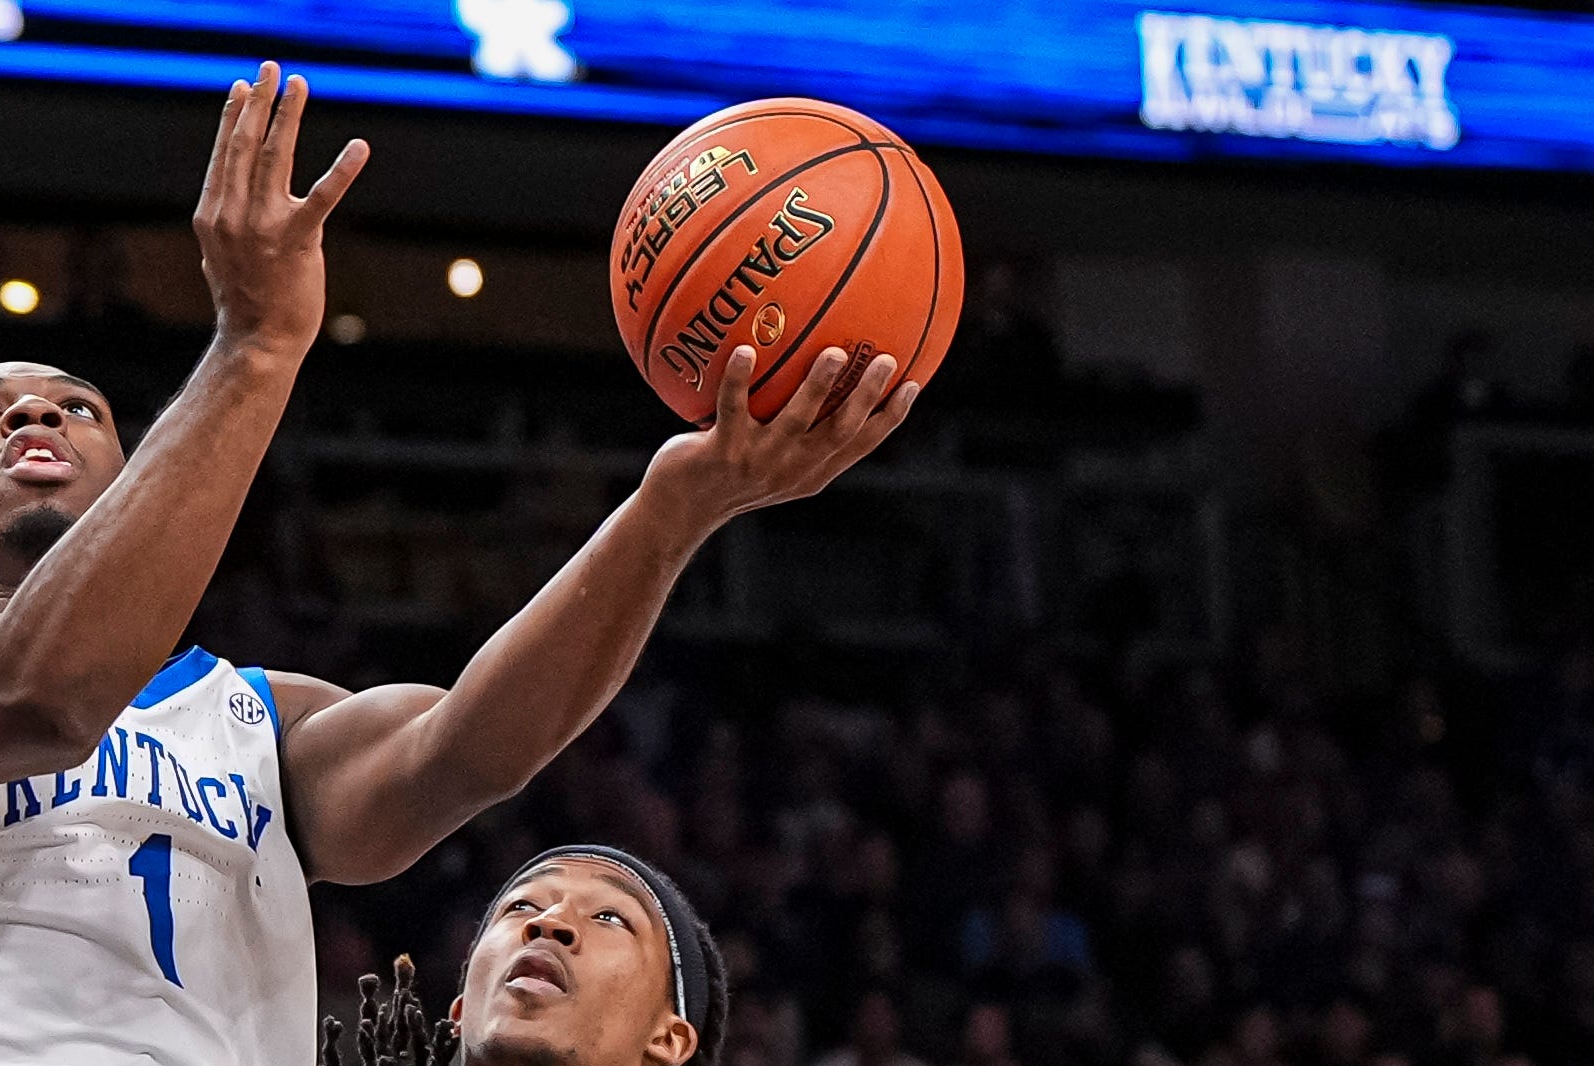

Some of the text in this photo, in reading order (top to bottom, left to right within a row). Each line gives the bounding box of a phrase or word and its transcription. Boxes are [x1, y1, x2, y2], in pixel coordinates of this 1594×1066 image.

[623, 148, 759, 313] LEGACY
[659, 186, 835, 392] SPALDING
[229, 692, 266, 725] SEC
[128, 833, 184, 989] 1
